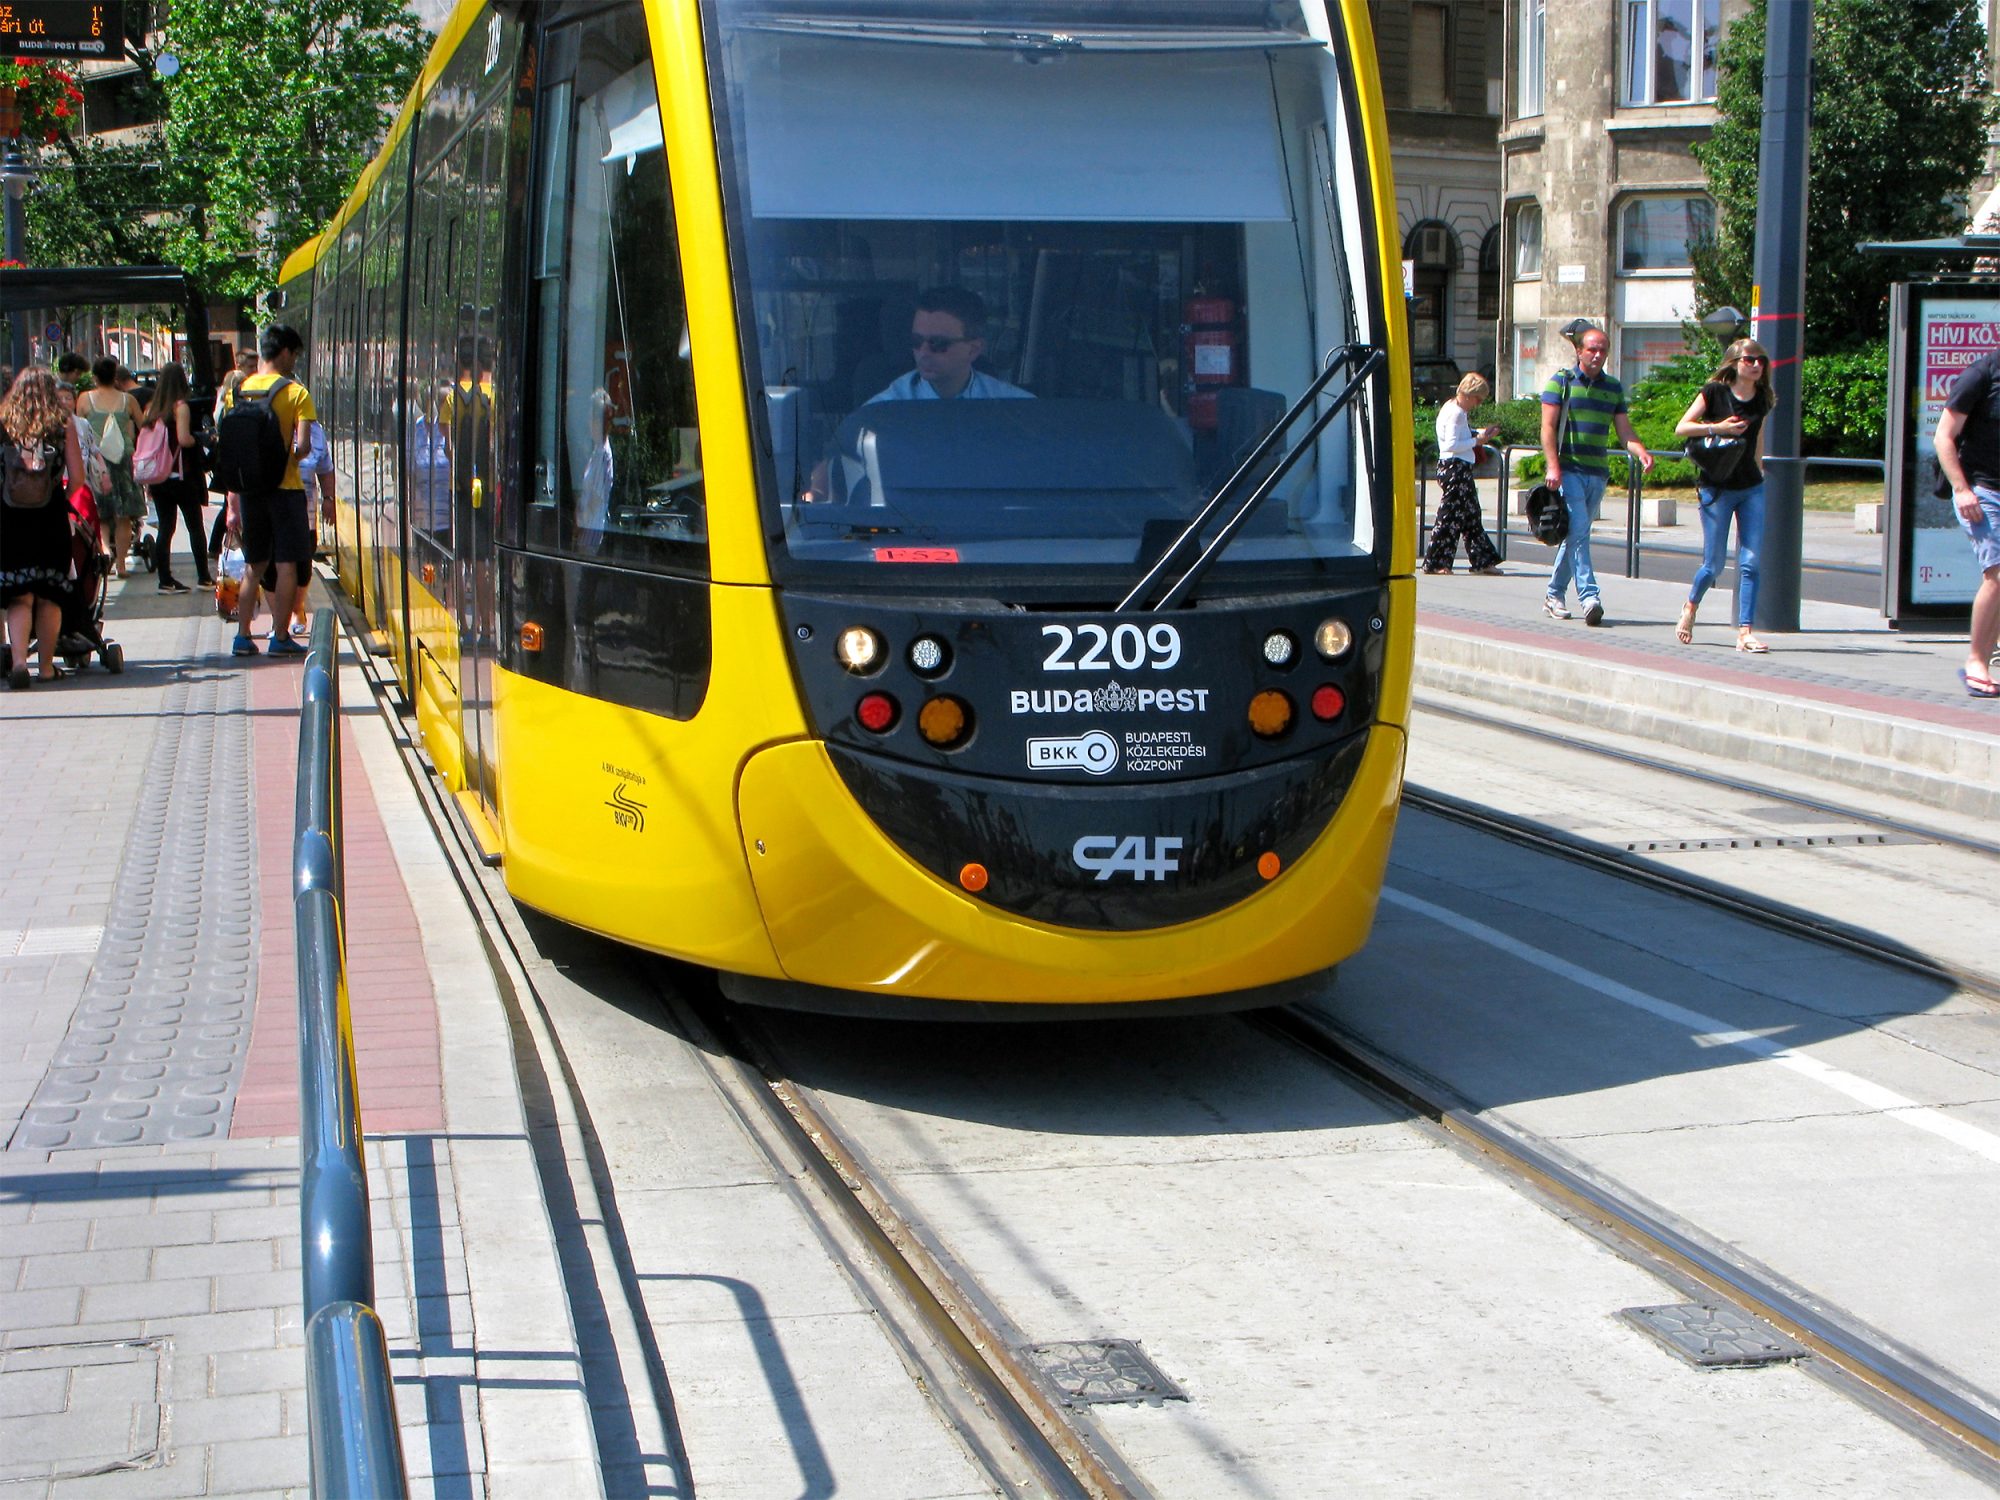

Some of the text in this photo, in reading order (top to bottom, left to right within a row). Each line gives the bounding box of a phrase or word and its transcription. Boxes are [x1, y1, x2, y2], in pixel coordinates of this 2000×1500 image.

[29, 19, 45, 34] út
[1931, 323, 1965, 345] HÍVJ
[1920, 566, 1933, 583] T
[1041, 623, 1182, 671] 2209
[1125, 732, 1191, 744] BUDAPESTI
[1040, 743, 1078, 760] BKK
[1126, 744, 1206, 757] KÖZLEKEDÉSI
[1127, 759, 1183, 771] KÖZPONT
[1072, 835, 1183, 881] CAF
